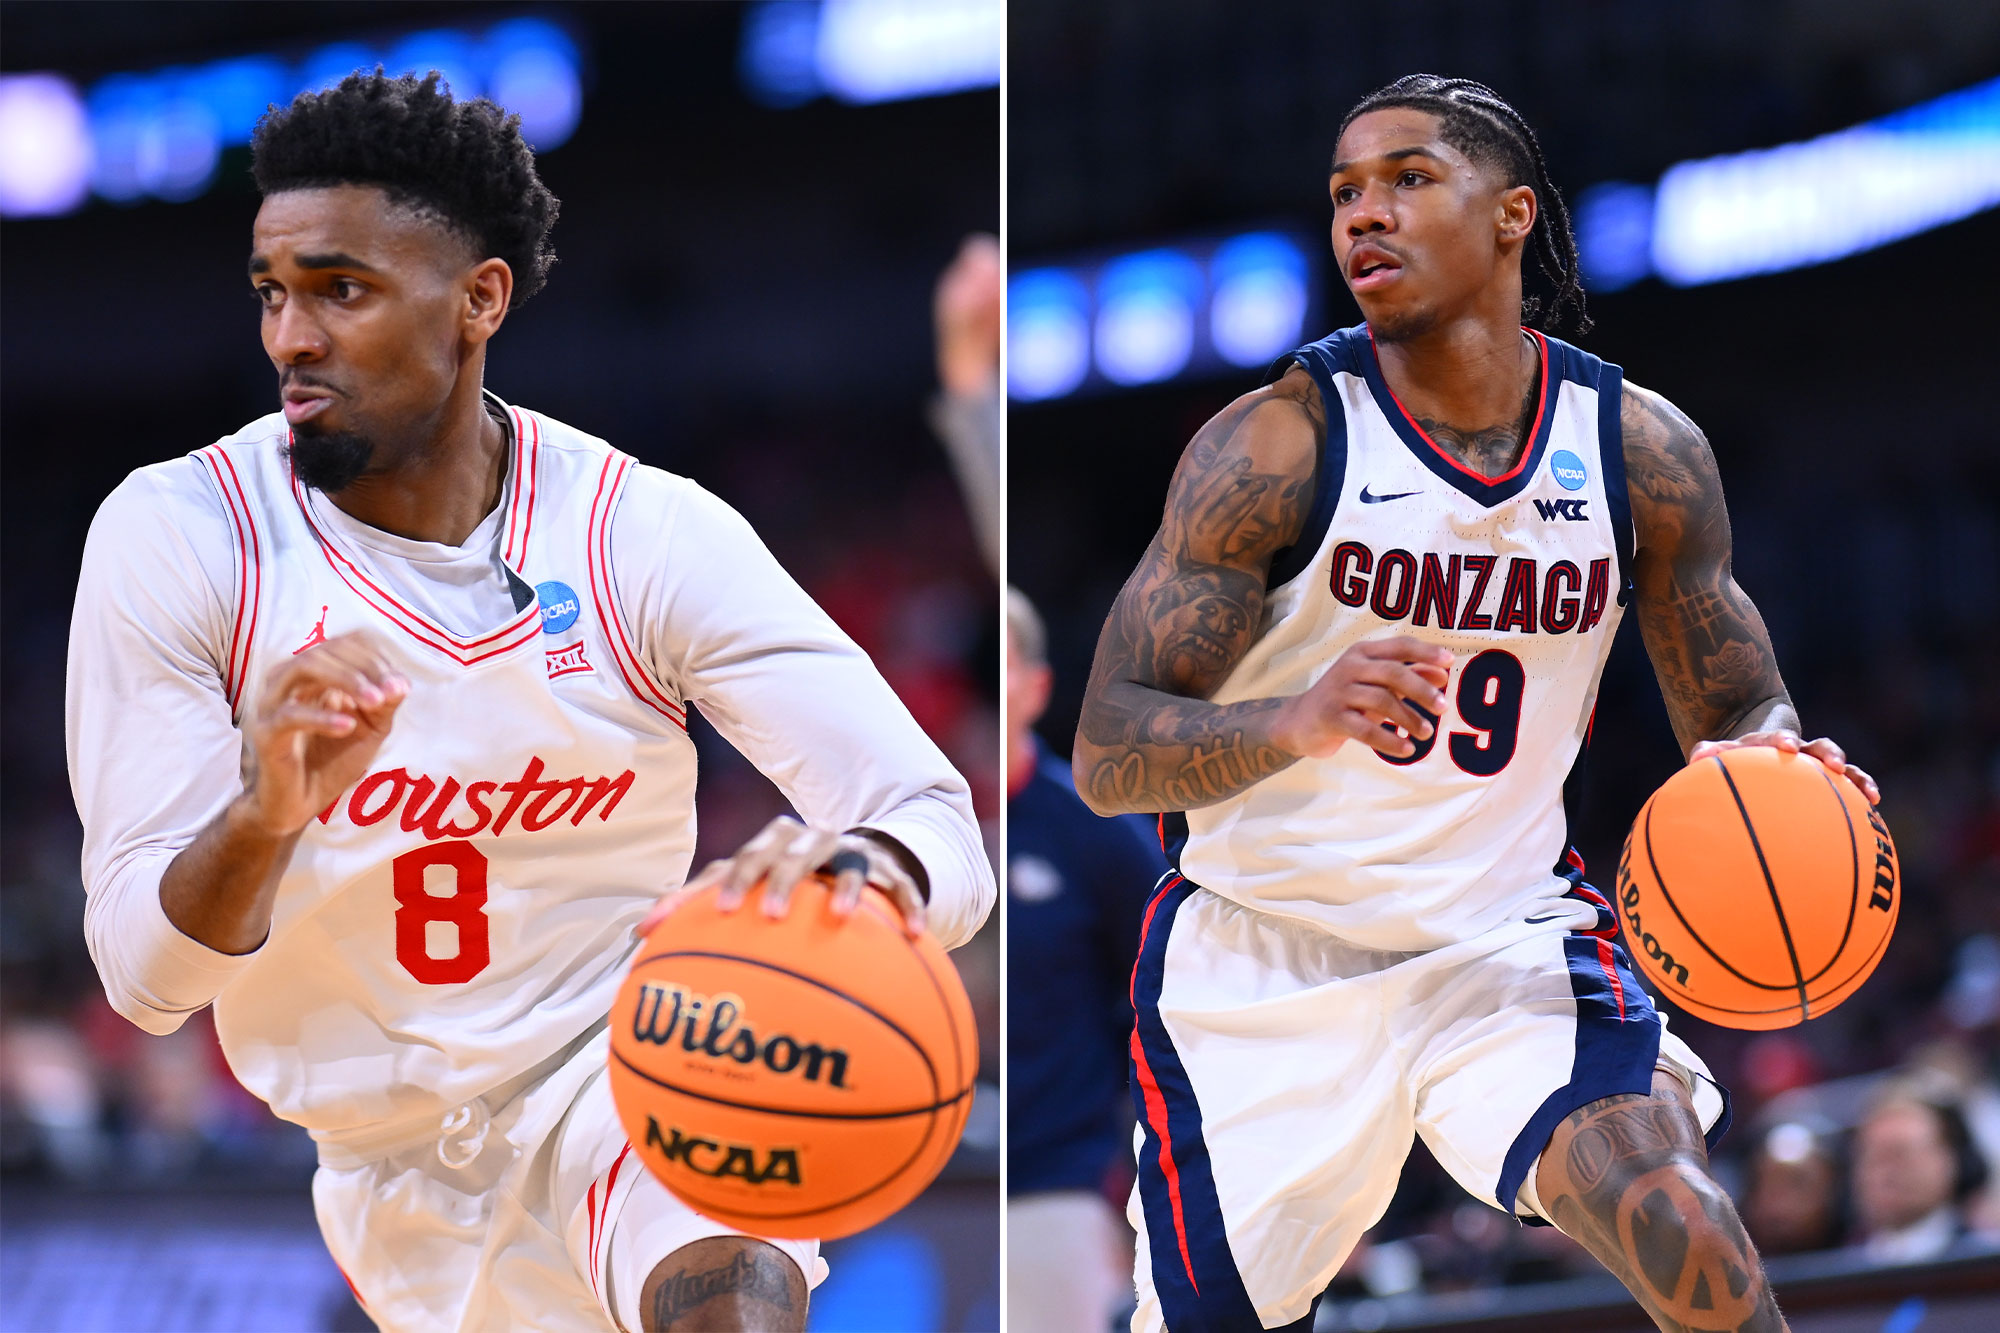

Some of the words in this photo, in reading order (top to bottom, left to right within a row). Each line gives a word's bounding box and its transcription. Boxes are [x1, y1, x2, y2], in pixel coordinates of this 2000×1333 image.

[1532, 498, 1590, 522] WCC
[1556, 467, 1586, 480] NCAA
[1329, 541, 1611, 635] GONZAGA
[318, 755, 636, 841] ouston
[392, 839, 491, 985] 8
[632, 983, 850, 1090] Wilson
[645, 1115, 802, 1186] NCAA
